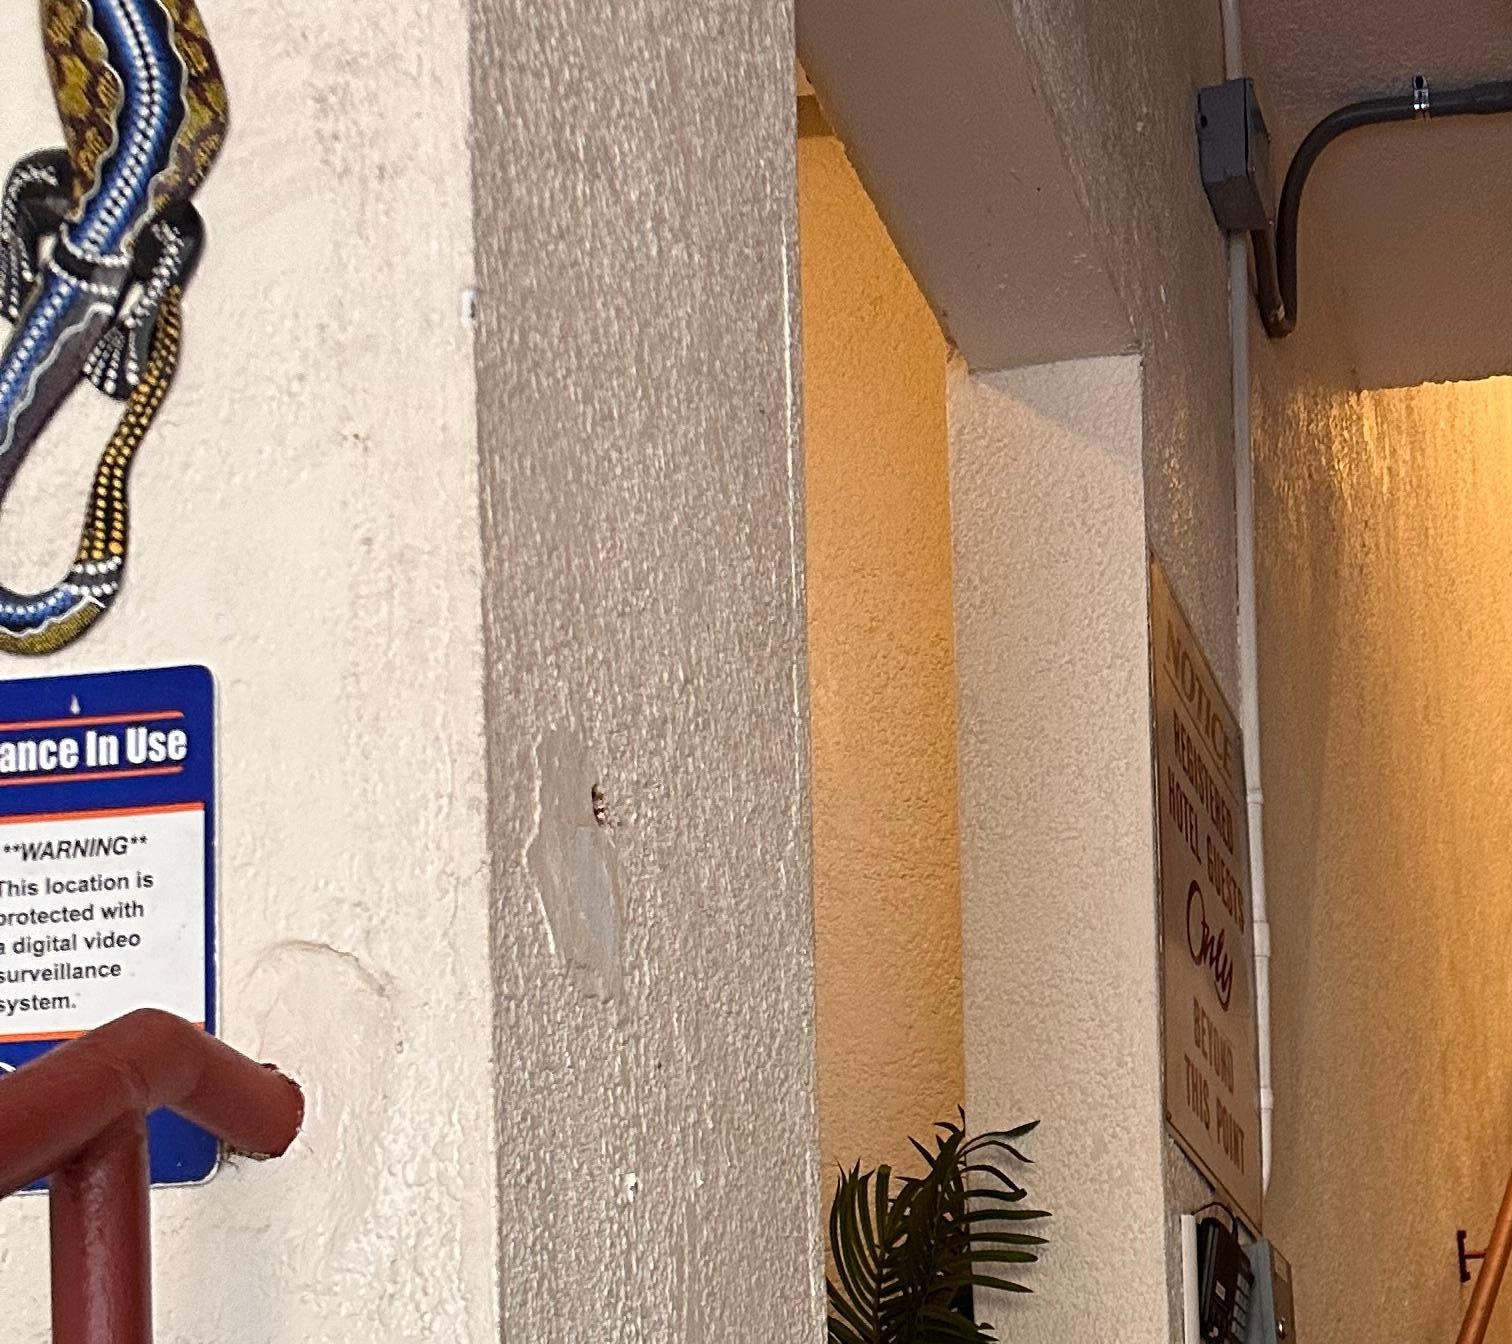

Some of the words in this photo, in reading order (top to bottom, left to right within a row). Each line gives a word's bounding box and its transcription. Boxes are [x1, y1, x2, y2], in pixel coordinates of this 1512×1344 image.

[0, 737, 79, 773] ance
[85, 730, 119, 767] In
[125, 726, 188, 764] Use
[1166, 618, 1233, 781] NOTICE
[1173, 709, 1233, 856] REGISTERED
[0, 878, 39, 898] This
[46, 874, 129, 895] location
[136, 870, 154, 888] is
[1168, 765, 1201, 865] HOTEL
[1206, 833, 1245, 934] GUESTS
[12, 933, 77, 957] digital
[83, 930, 141, 950] video
[101, 900, 144, 920] with
[1187, 879, 1233, 1012] Only
[1193, 995, 1234, 1095] BEYOND
[1184, 1053, 1211, 1131] THIS
[1216, 1096, 1245, 1175] POINT
